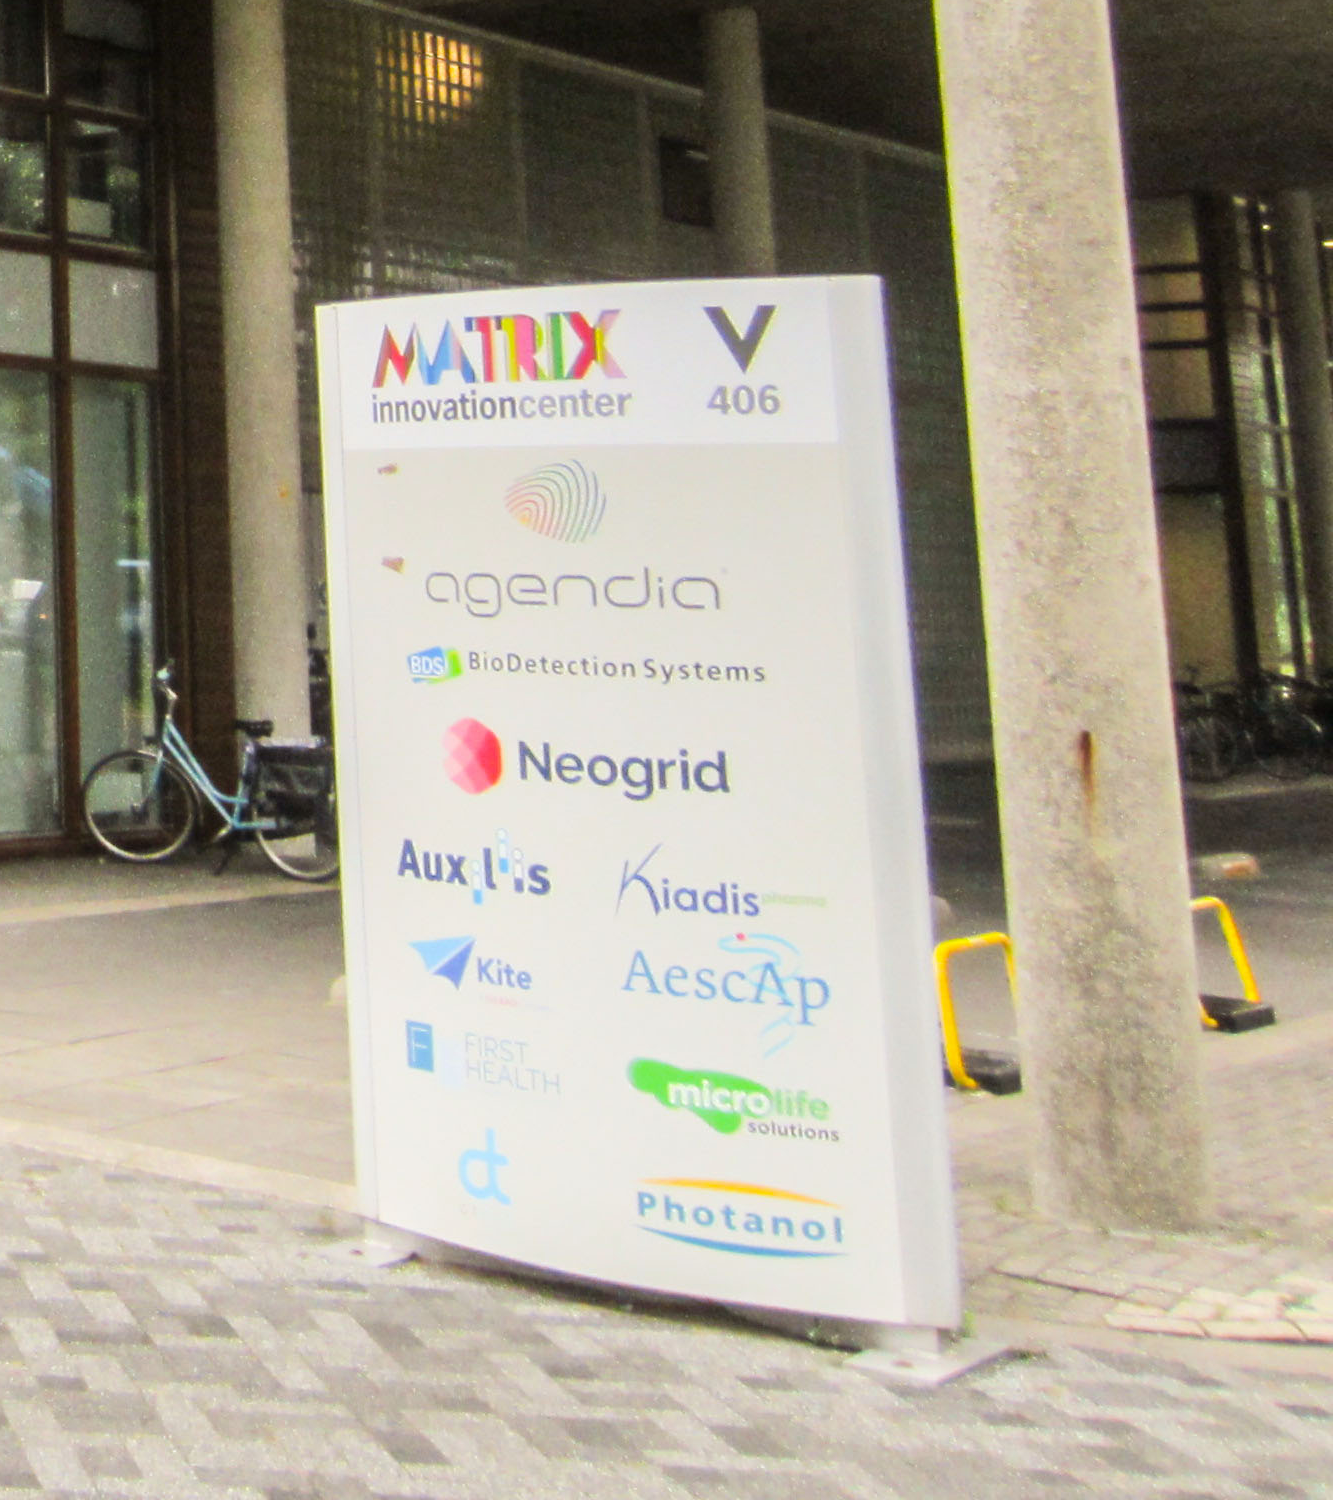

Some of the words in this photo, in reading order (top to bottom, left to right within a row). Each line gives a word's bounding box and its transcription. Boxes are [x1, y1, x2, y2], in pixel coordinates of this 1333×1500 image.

[372, 309, 627, 388] MATRIX
[371, 389, 632, 423] innovationcenter
[707, 384, 781, 415] 406
[426, 567, 721, 618] agendia
[410, 655, 445, 676] BDS
[469, 651, 636, 678] BioDetection
[643, 658, 766, 684] Systems
[518, 740, 731, 801] Neogrid
[615, 843, 760, 917] Kiadis
[477, 957, 533, 991] Kite
[621, 950, 830, 1026] AescAp
[464, 1032, 529, 1064] FIRST
[464, 1058, 562, 1096] HEALTH
[748, 1120, 840, 1142] solutions
[637, 1191, 843, 1243] Photanol
